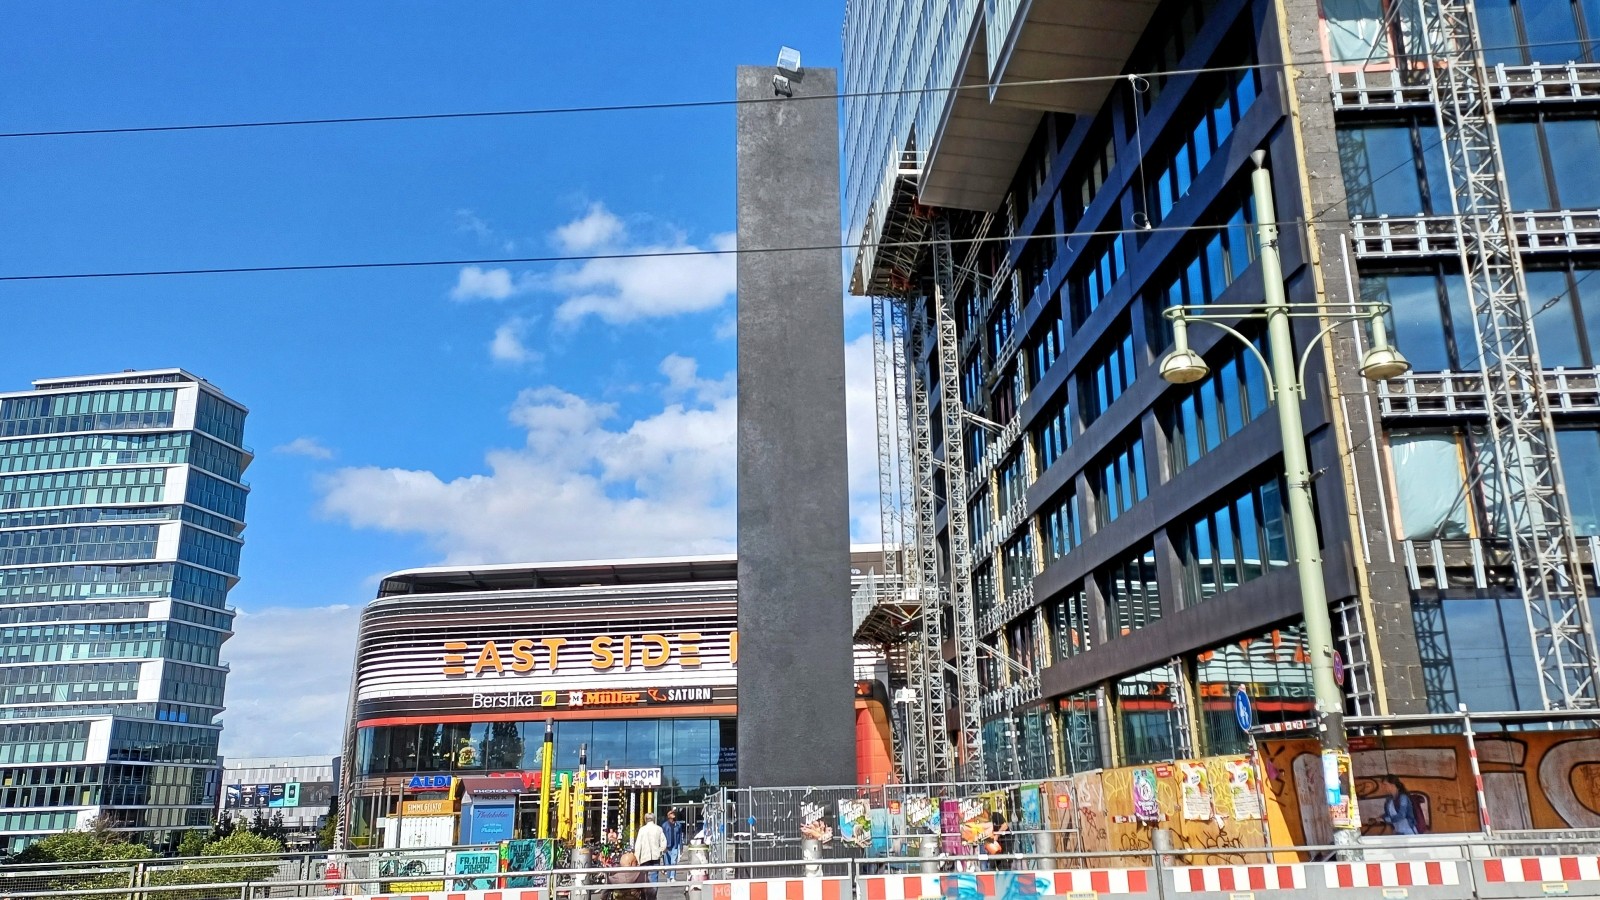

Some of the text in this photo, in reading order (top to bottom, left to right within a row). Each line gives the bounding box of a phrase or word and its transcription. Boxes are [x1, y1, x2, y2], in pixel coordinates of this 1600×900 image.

[443, 638, 568, 675] EAST
[591, 632, 702, 669] SIDE
[472, 691, 535, 709] Bershka
[585, 689, 640, 706] Müller
[668, 688, 711, 701] SATURN
[408, 774, 452, 788] ALDI
